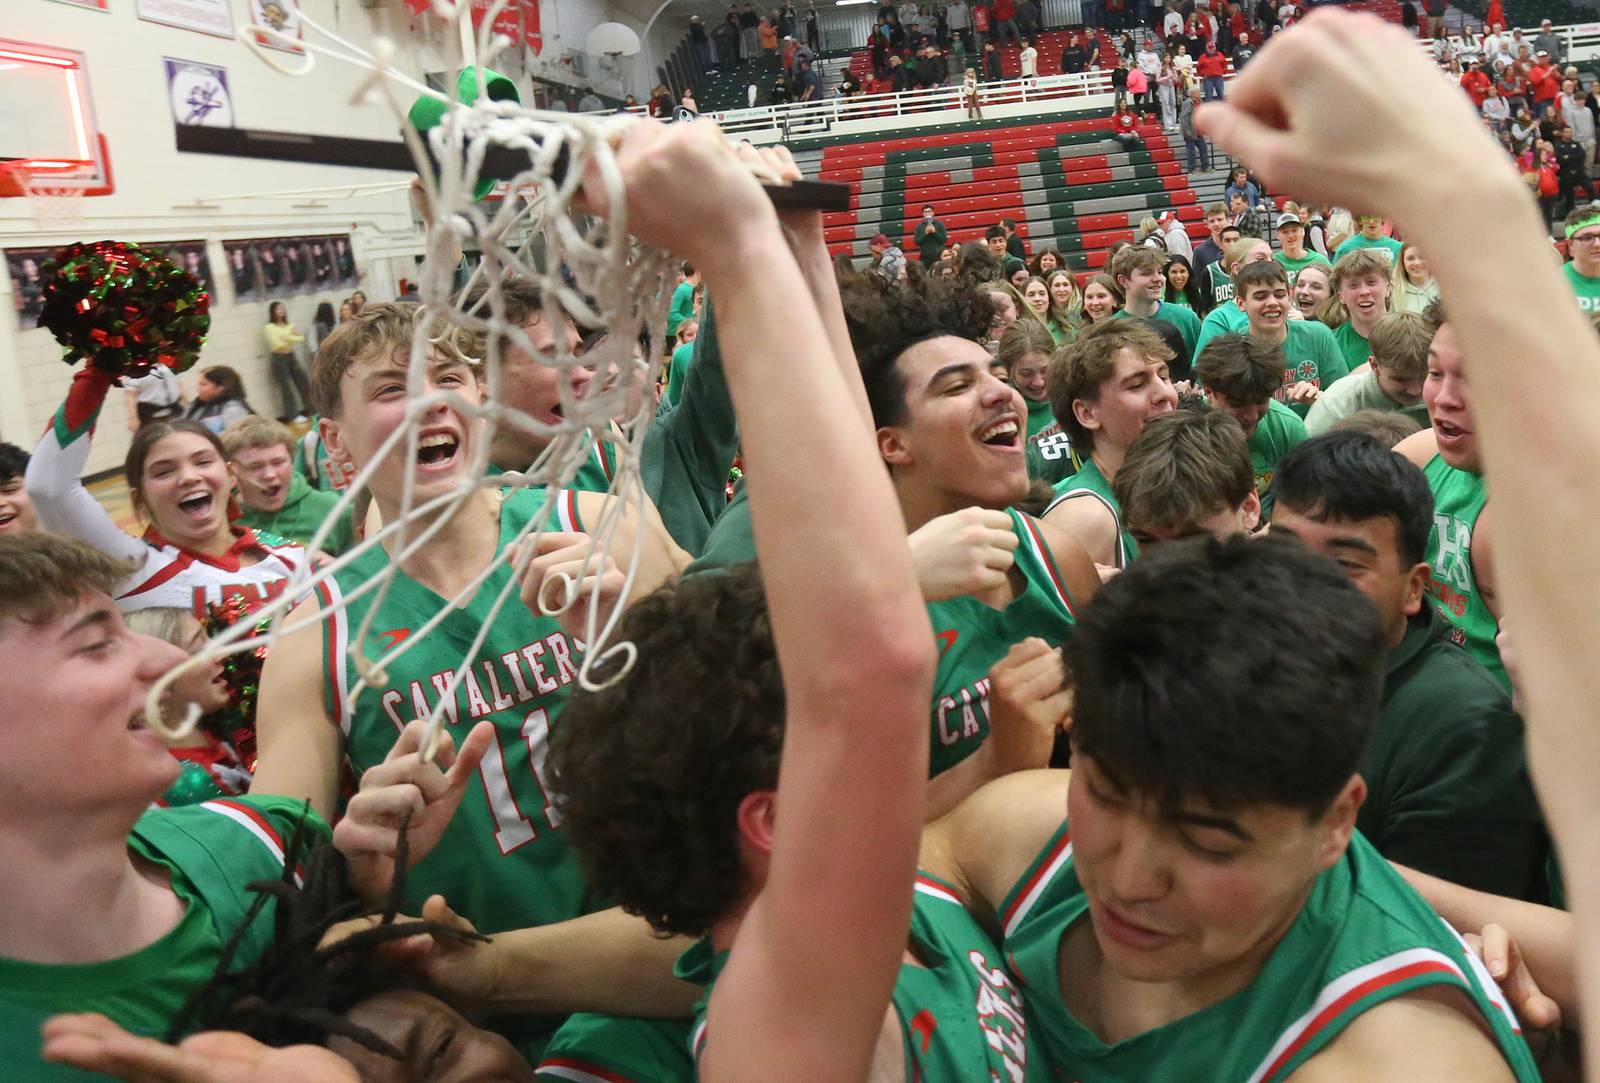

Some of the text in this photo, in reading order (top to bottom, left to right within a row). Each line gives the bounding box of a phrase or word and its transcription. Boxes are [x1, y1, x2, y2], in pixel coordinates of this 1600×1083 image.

[1215, 283, 1235, 302] BOS
[1037, 432, 1071, 460] 55
[381, 631, 586, 735] CAVALIER
